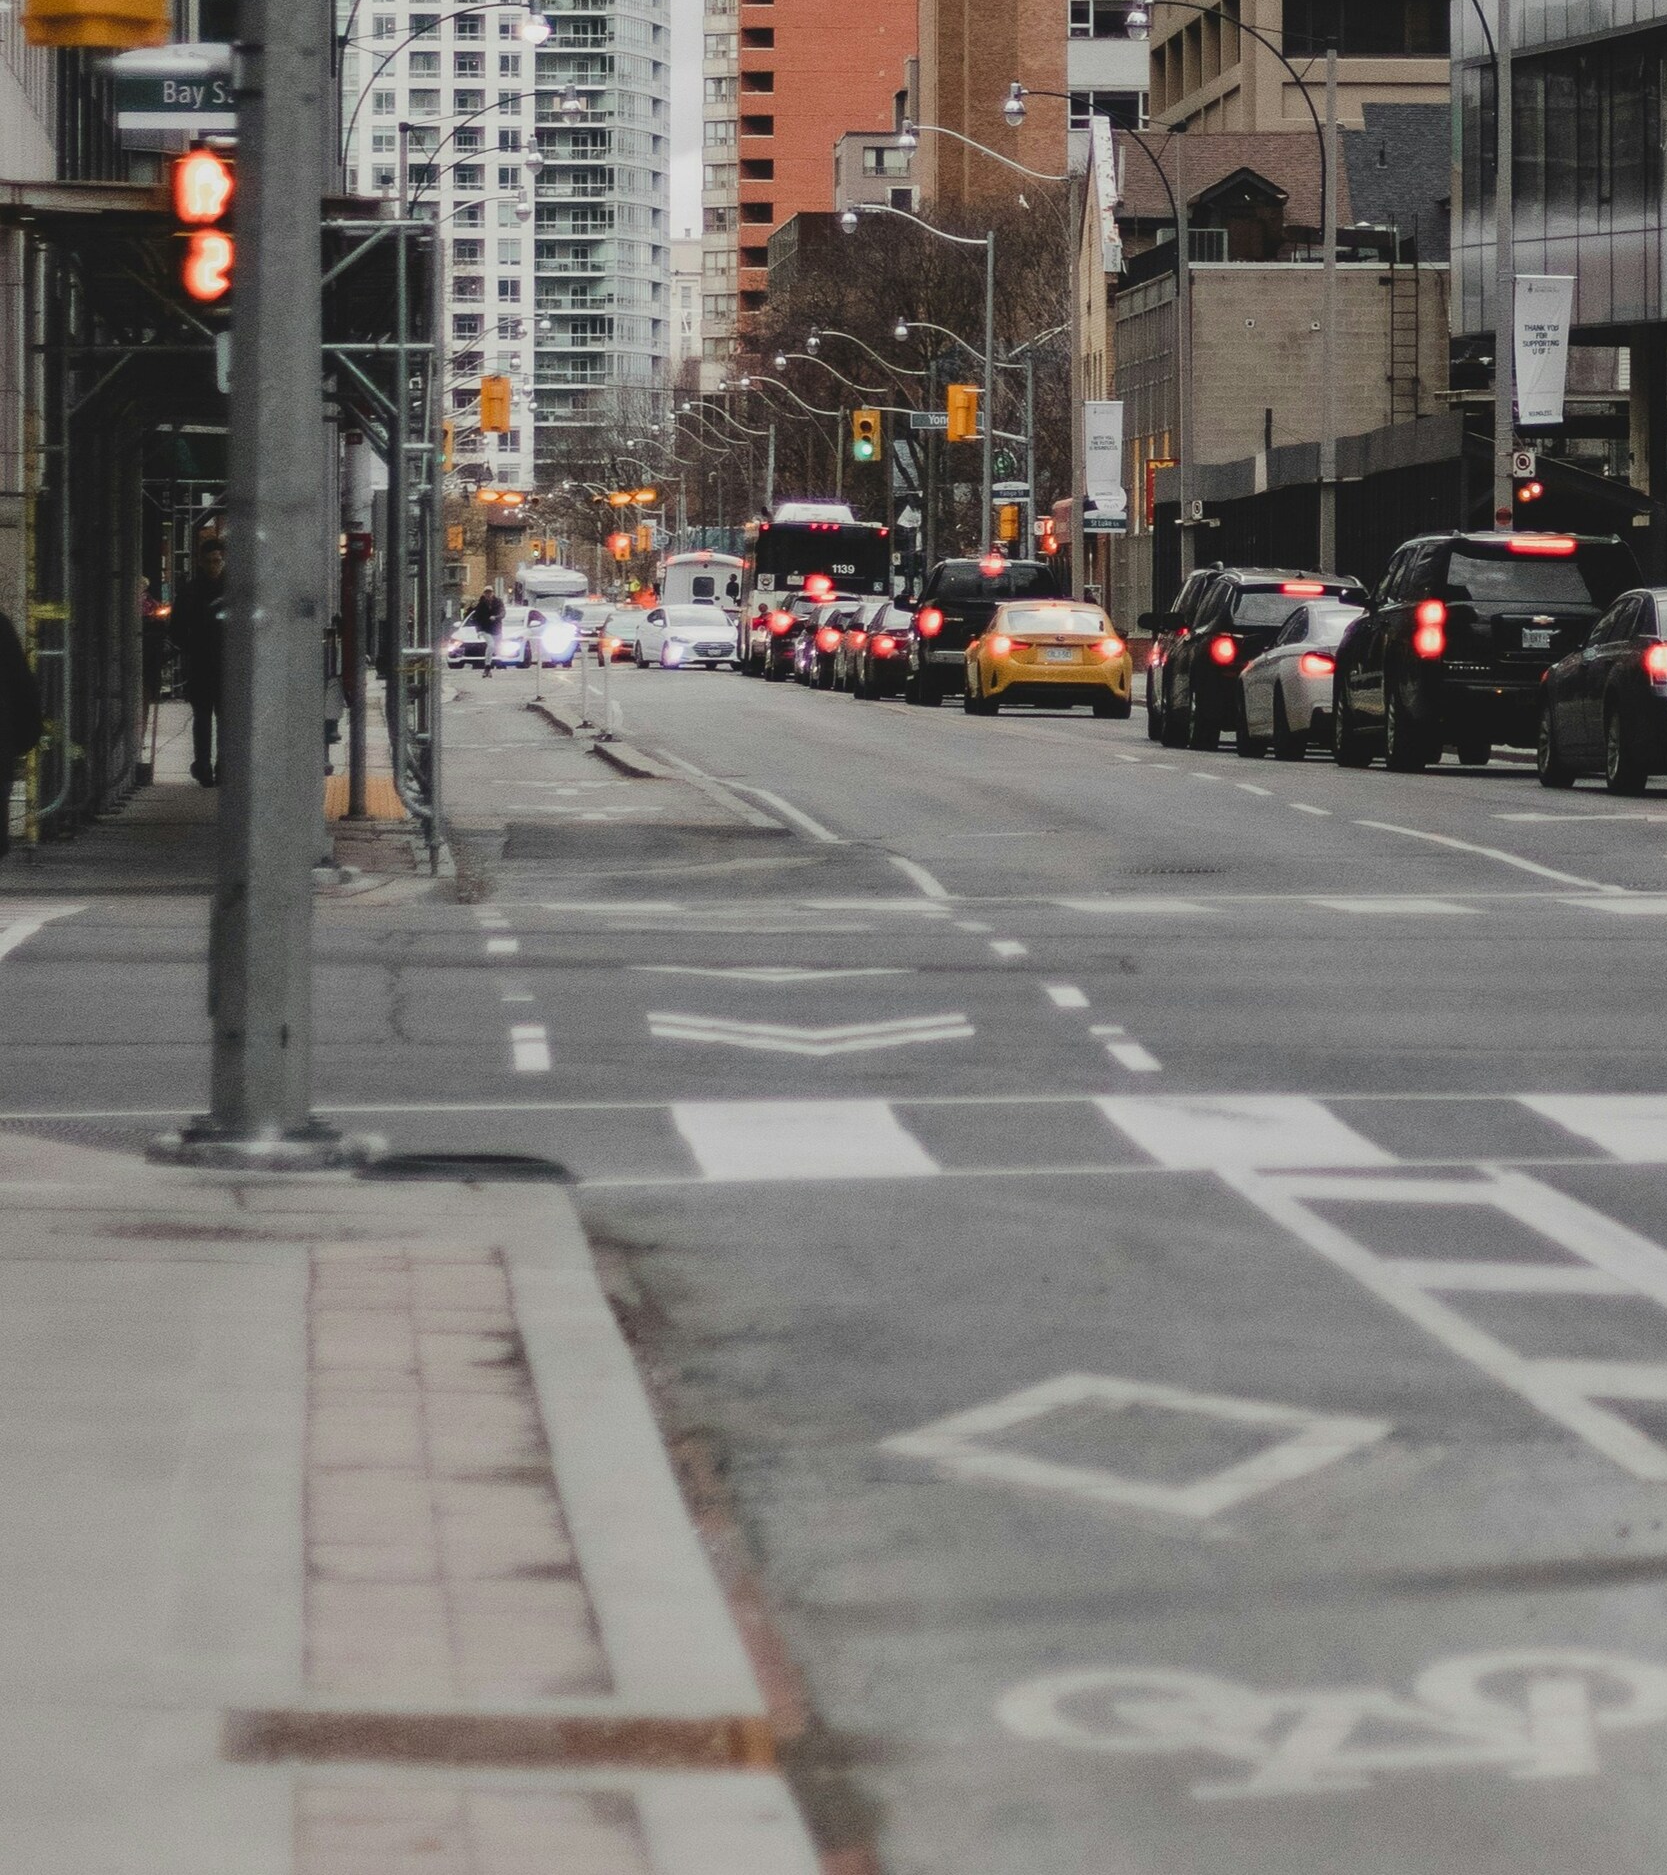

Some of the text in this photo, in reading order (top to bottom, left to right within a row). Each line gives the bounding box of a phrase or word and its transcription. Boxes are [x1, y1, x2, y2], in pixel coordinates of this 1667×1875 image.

[163, 80, 204, 109] Bay
[1524, 324, 1545, 332] THANK
[831, 564, 855, 574] 1139
